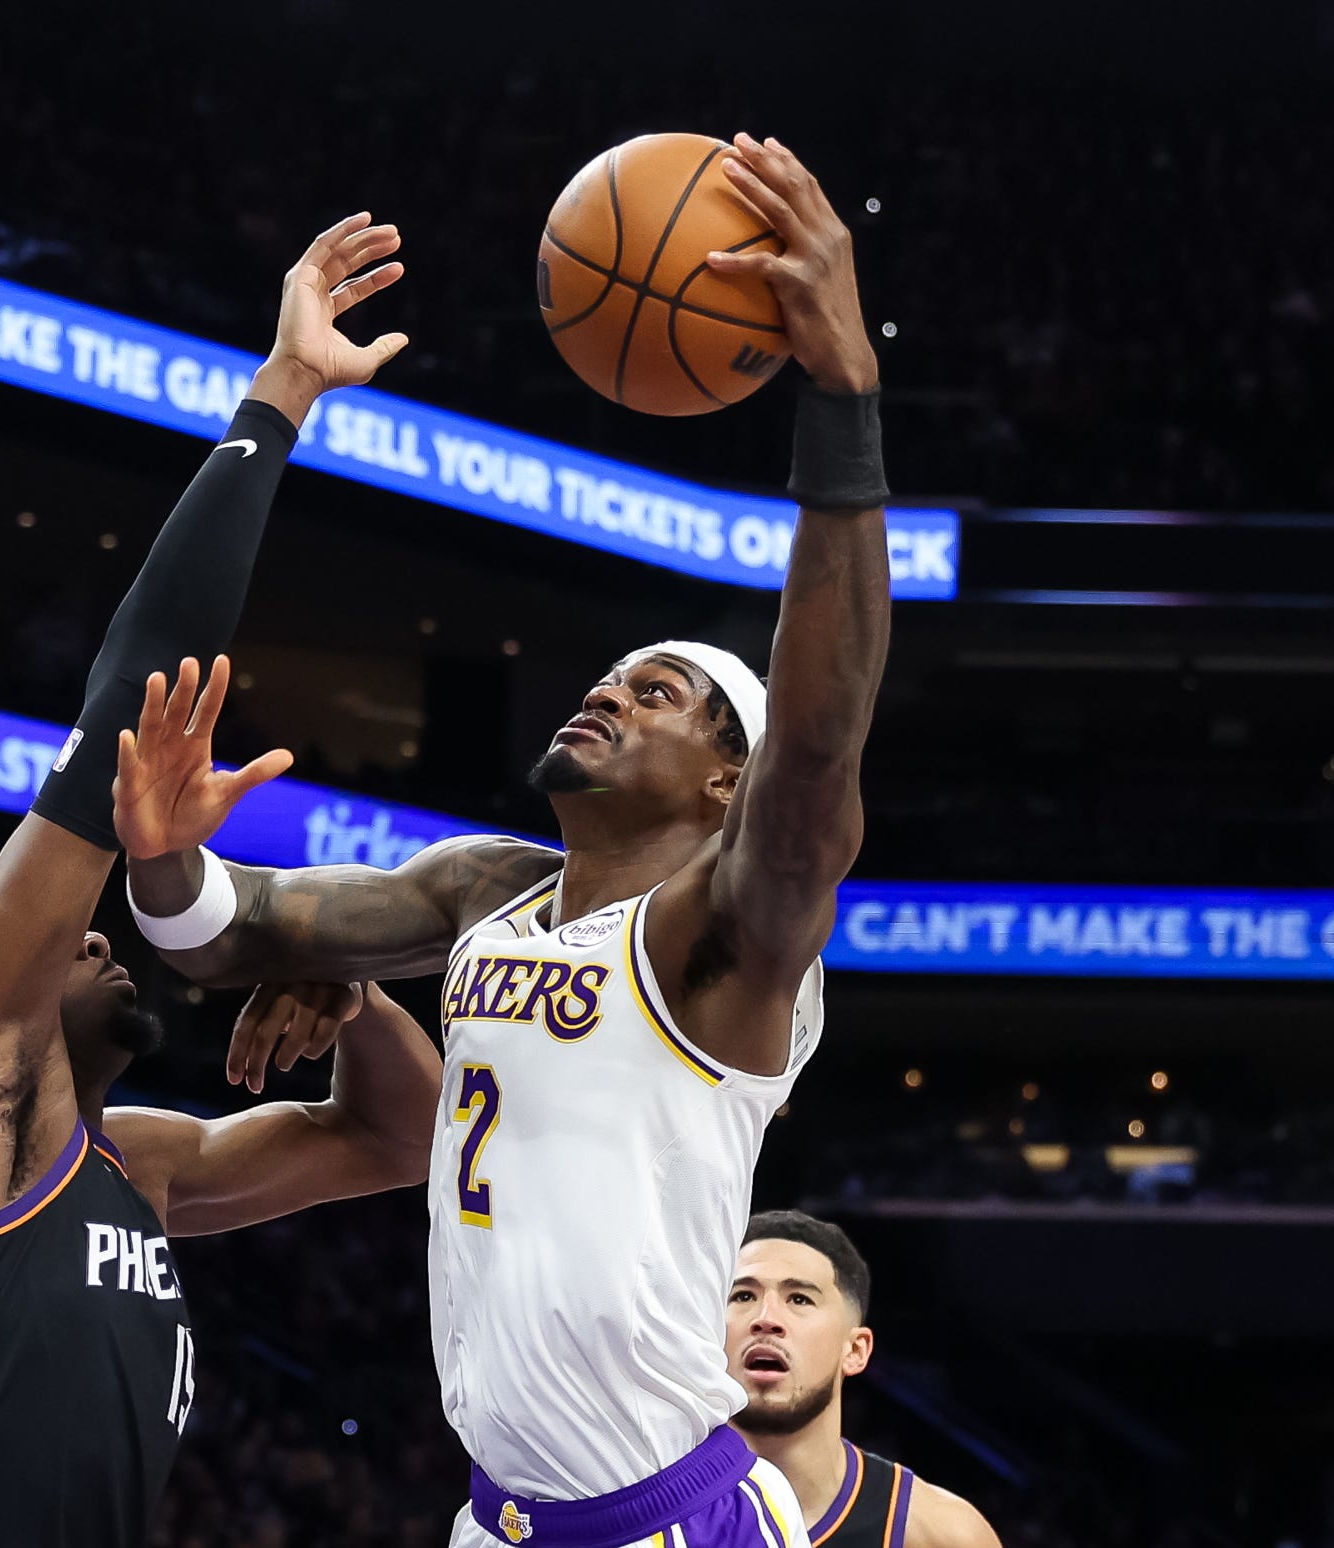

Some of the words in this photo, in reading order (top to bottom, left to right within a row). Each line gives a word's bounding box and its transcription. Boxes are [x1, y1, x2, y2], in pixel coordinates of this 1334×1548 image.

[69, 326, 159, 400] THE
[326, 403, 426, 476] SELL
[434, 434, 550, 510] YOUR
[556, 468, 724, 559] TICKETS
[568, 921, 620, 938] bibigo
[844, 901, 1017, 953] CAN'T
[1027, 907, 1189, 957] MAKE
[1201, 909, 1308, 959] THE
[453, 1063, 502, 1230] 2
